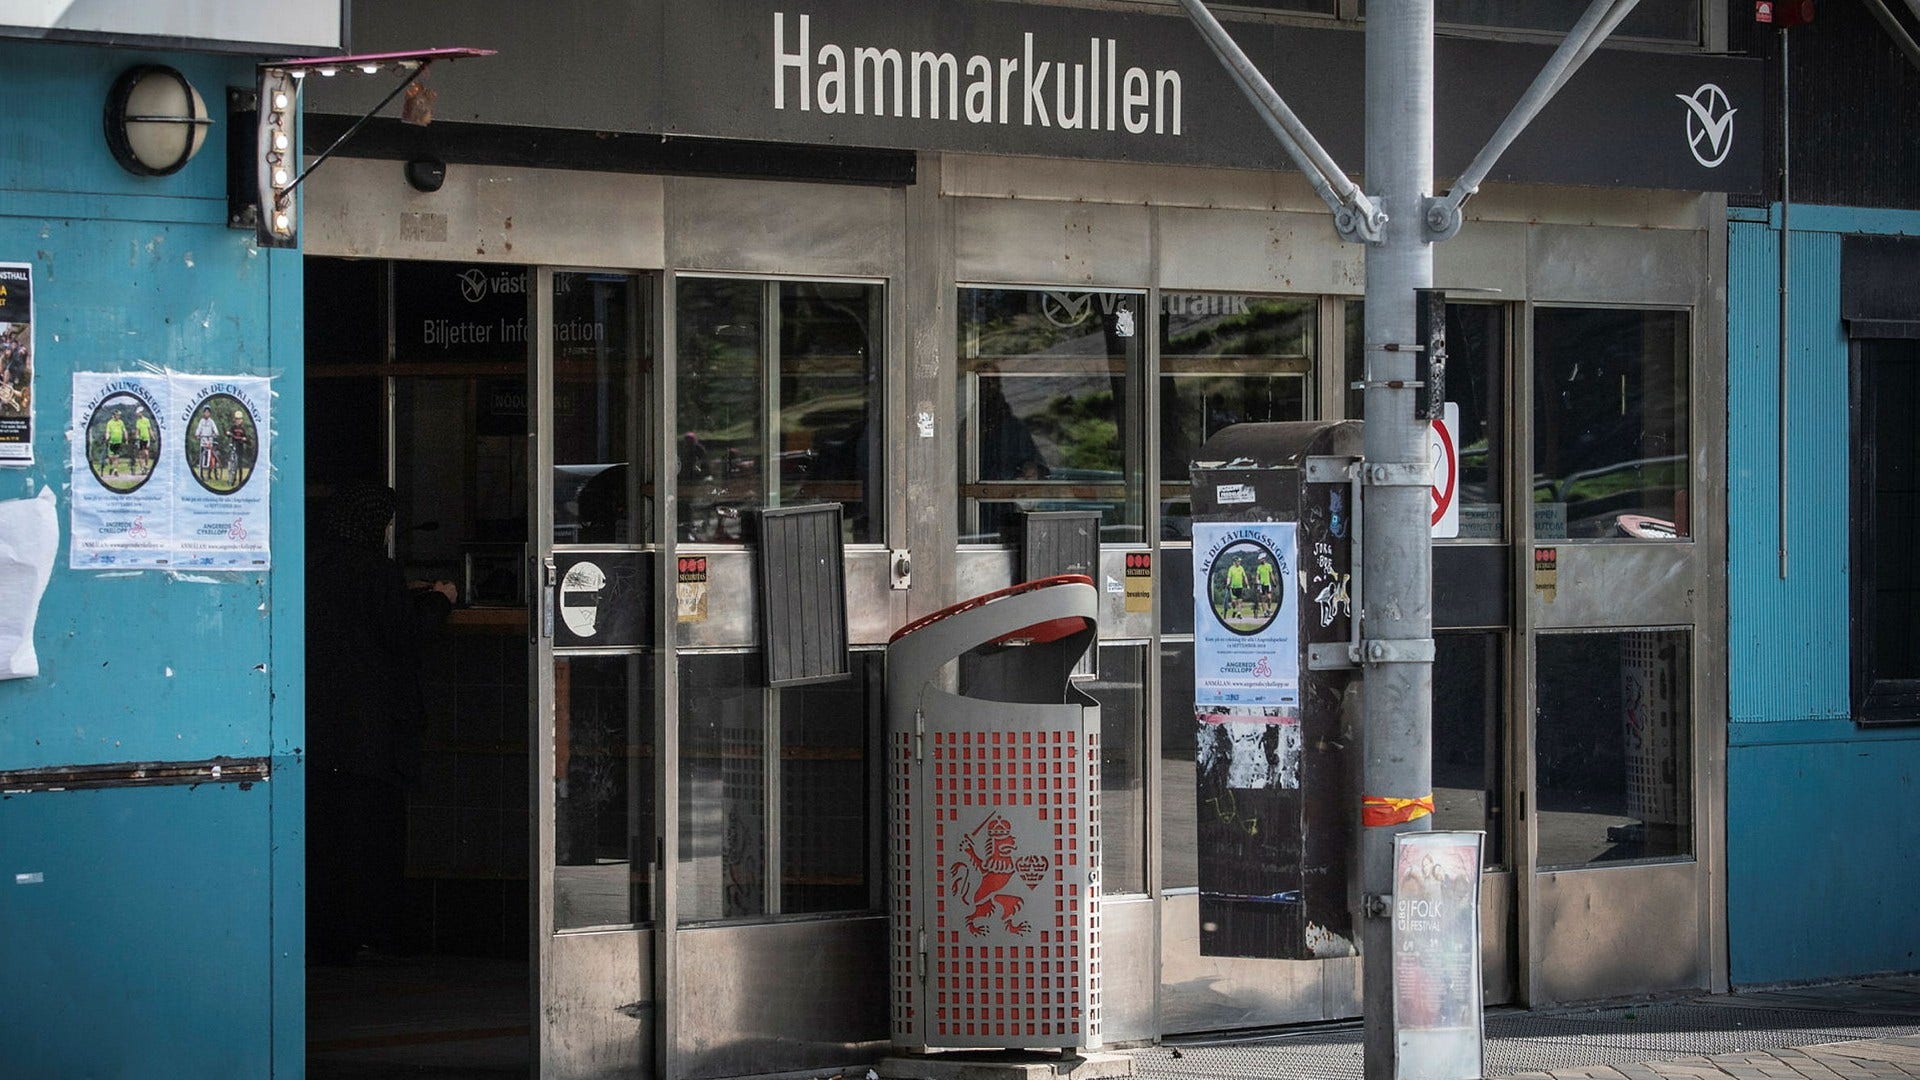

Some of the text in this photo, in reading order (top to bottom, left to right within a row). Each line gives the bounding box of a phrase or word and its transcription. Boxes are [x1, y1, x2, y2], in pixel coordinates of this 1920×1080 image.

[773, 12, 1181, 136] Hammarkullen
[424, 318, 493, 349] Biljetter
[181, 384, 262, 424] GILLAR DU CYKLING?
[1200, 529, 1290, 576] ÄR DU TÄVLINGSSUGEN?
[1411, 900, 1443, 918] FOLK
[1411, 920, 1441, 932] FESTIVAL
